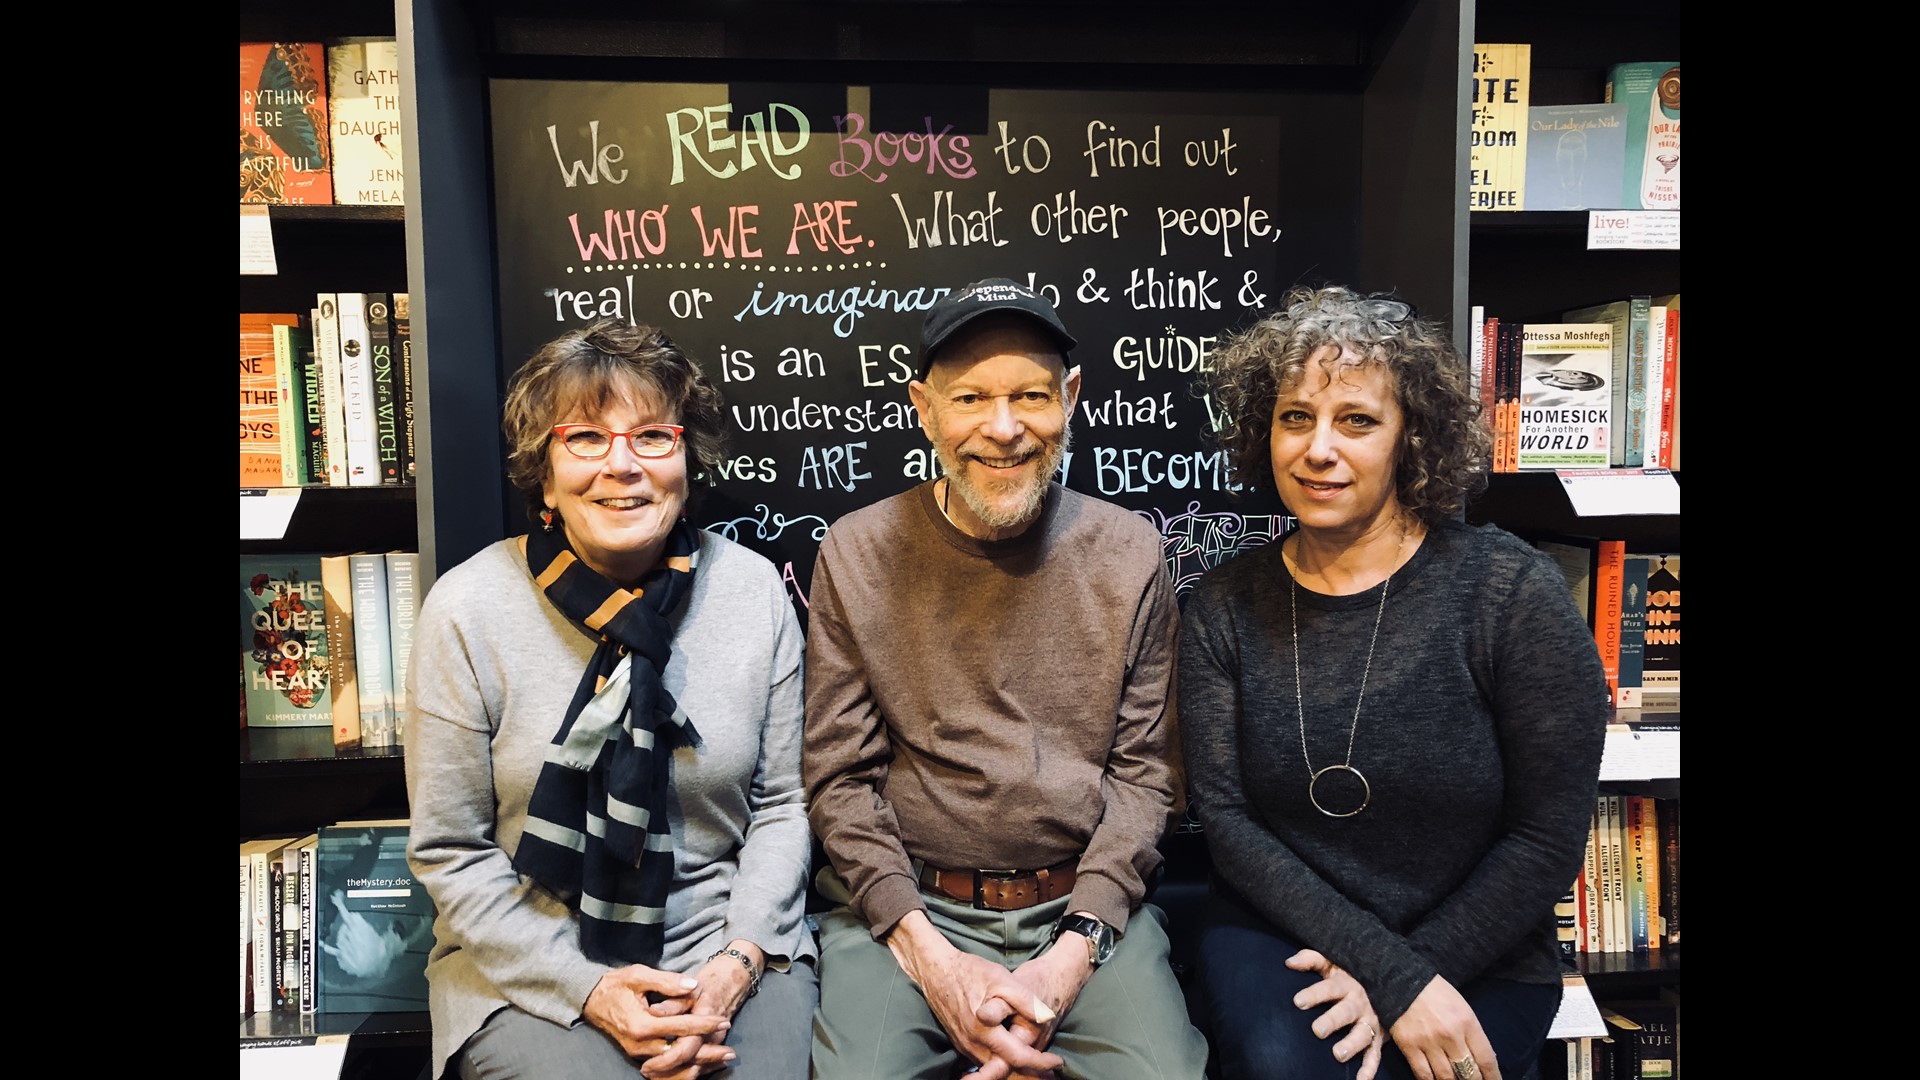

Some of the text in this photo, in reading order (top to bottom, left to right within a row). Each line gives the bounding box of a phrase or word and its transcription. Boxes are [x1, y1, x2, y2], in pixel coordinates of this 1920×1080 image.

[244, 89, 316, 105] RYTHING
[373, 95, 400, 110] TH
[243, 111, 283, 128] HERE
[259, 135, 271, 150] IS
[547, 103, 1238, 187] We READ Books to find out
[241, 156, 314, 173] AUTIFUL
[568, 190, 1282, 261] WHO WE ARE. What other people,
[1594, 215, 1629, 229] live!
[552, 275, 637, 327] real
[669, 287, 713, 319] or
[734, 280, 952, 338] imaginar
[1076, 267, 1110, 303] &
[1124, 267, 1221, 310] think
[1238, 270, 1267, 309] &
[977, 292, 1018, 302] Mind
[1522, 331, 1610, 342] Ottessa Moshfegh
[720, 328, 1217, 387] is an ES GUIDE
[1666, 337, 1674, 362] MOYES
[373, 345, 392, 383] SON
[304, 363, 320, 424] WICKED
[377, 385, 390, 395] of
[1082, 390, 1177, 429] what
[1521, 410, 1608, 424] HOMESICK
[378, 402, 397, 462] WITCH
[1525, 425, 1584, 433] For Another
[1520, 435, 1589, 450] WORLD
[798, 441, 872, 493] ARE
[1609, 550, 1618, 570] THE
[269, 580, 322, 600] THE
[358, 576, 375, 595] THE
[395, 574, 412, 593] THE
[1608, 575, 1617, 618] RUINED
[252, 610, 326, 631] QUEE
[359, 598, 377, 631] WORLD
[397, 597, 413, 630] WORLD
[1649, 610, 1671, 626] IN
[335, 632, 343, 658] Piano
[1605, 622, 1616, 661] HOUSE
[1645, 629, 1680, 645] INK
[281, 640, 319, 660] OF
[337, 662, 345, 687] Tuner
[265, 713, 308, 721] KIMMERY
[1634, 834, 1642, 852] for
[1635, 856, 1643, 883] Love
[347, 877, 411, 888] theMystery.doc
[302, 856, 310, 940] THE NORTH WATER
[286, 931, 295, 944] JON
